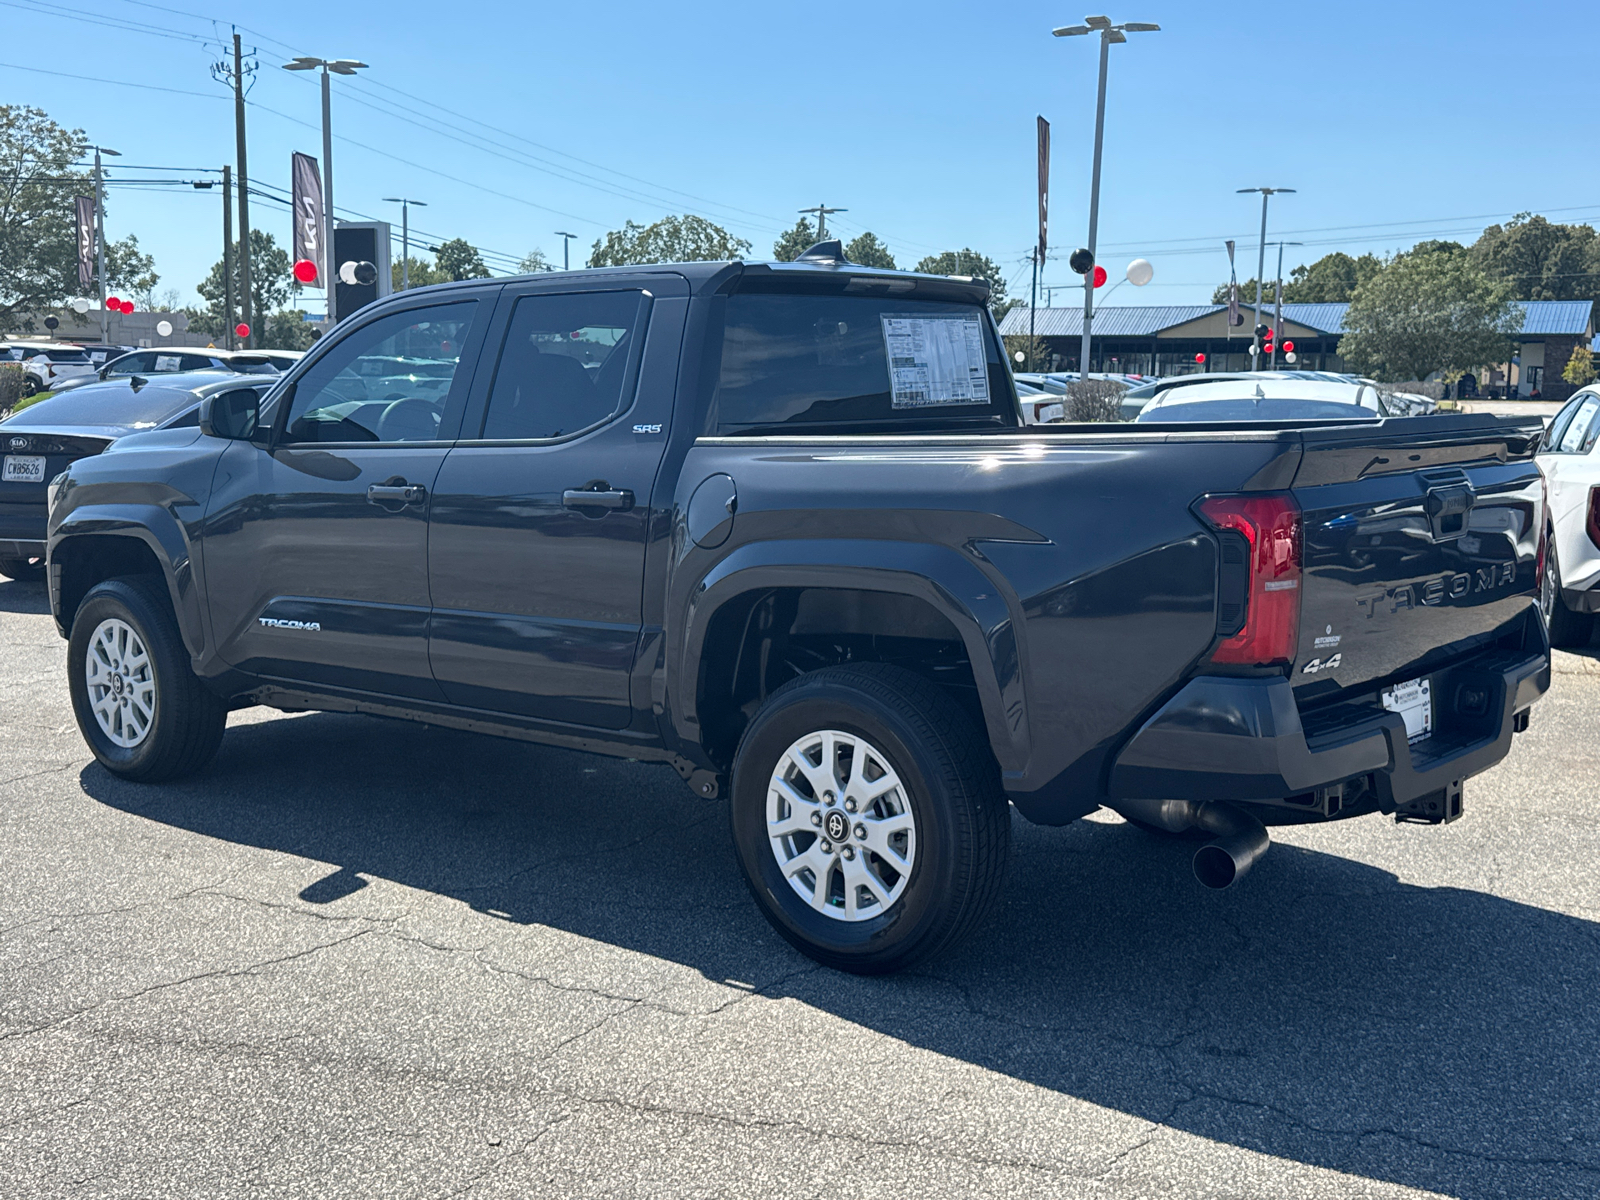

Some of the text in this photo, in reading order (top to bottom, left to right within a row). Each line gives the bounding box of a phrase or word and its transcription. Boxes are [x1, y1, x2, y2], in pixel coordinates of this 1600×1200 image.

[11, 439, 25, 447] KIA
[1355, 560, 1516, 619] TACOMA
[258, 617, 321, 631] TACOMA
[1303, 652, 1342, 674] 4x4
